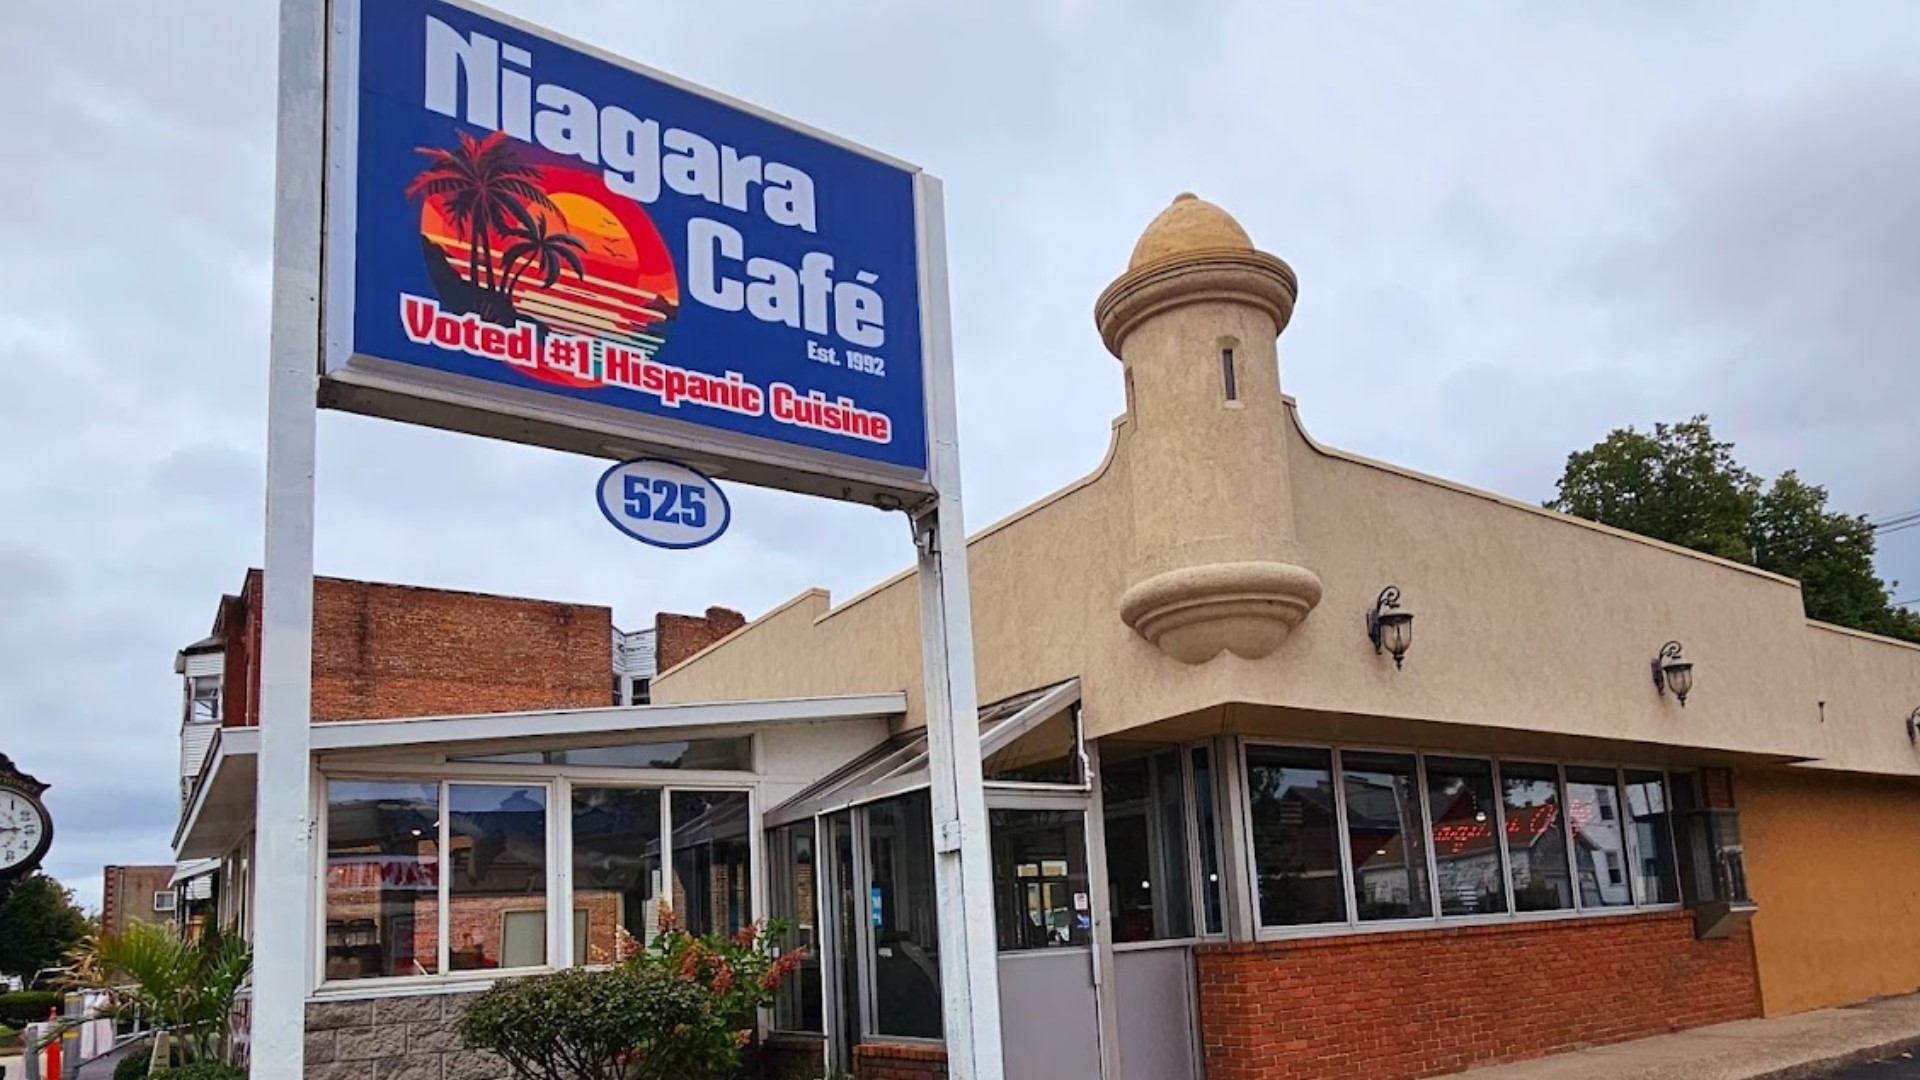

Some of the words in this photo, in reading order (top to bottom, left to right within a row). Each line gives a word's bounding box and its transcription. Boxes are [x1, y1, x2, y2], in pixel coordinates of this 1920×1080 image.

[424, 15, 816, 233] Niagara
[687, 217, 884, 348] Café
[405, 298, 534, 364] Voted
[550, 338, 590, 376] #1
[605, 346, 761, 409] Hispanic
[773, 386, 888, 439] Cuisine
[806, 339, 841, 366] Est.
[845, 350, 886, 377] 1992
[622, 473, 708, 529] 525
